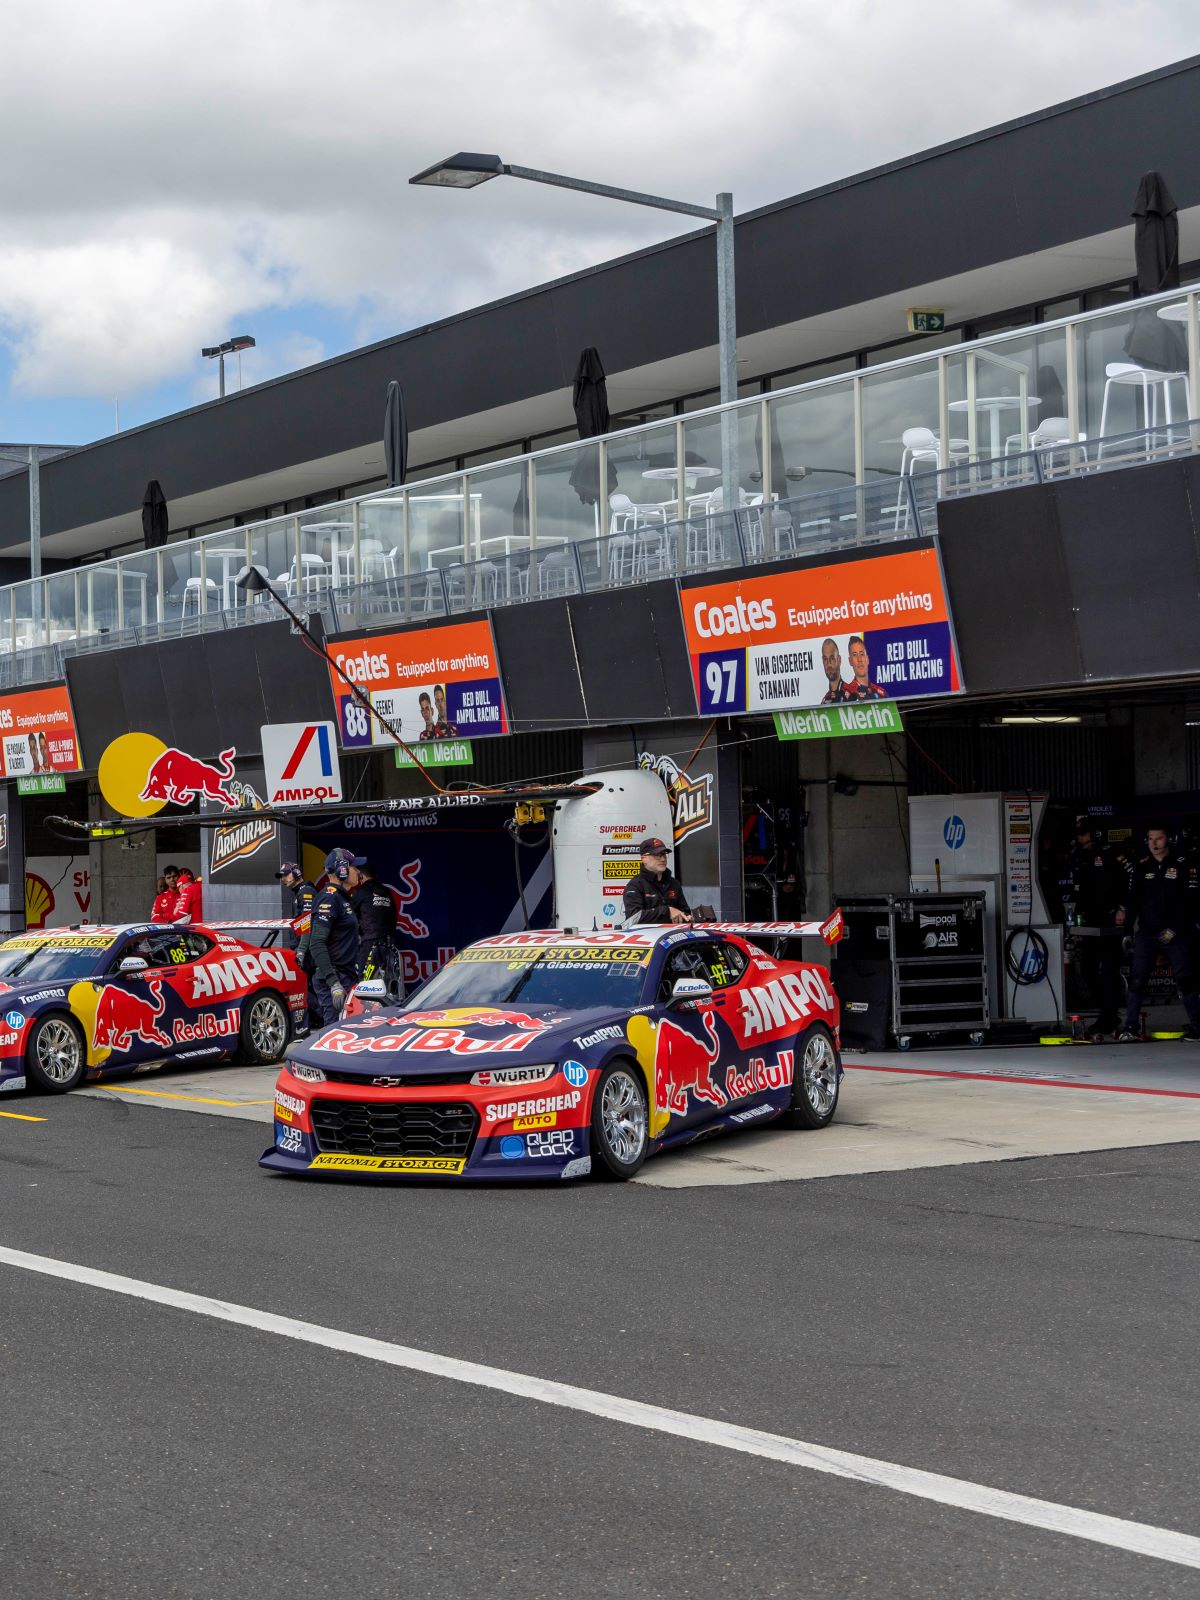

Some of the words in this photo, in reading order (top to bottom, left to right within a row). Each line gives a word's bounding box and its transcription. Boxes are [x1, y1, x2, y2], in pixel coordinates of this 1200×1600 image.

[693, 596, 777, 638] Coates
[787, 601, 849, 628] Equipped
[850, 599, 870, 618] for
[872, 590, 933, 615] anything
[886, 642, 906, 661] RED
[907, 639, 931, 658] BULL
[336, 651, 390, 684] Coates
[396, 658, 436, 678] Equipped
[436, 657, 449, 673] for
[450, 653, 489, 672] anything
[755, 655, 770, 677] VAN
[771, 651, 813, 674] GISBERGEN
[876, 662, 909, 685] AMPOL
[909, 658, 943, 682] RACING
[705, 659, 738, 705] 97
[758, 677, 801, 701] STANAWAY
[462, 691, 474, 706] RED
[475, 689, 491, 705] BULL
[376, 698, 394, 715] FEENEY
[456, 708, 477, 725] AMPOL
[477, 705, 499, 723] RACING
[344, 700, 368, 738] 88
[779, 710, 832, 736] Merlin
[838, 704, 895, 731] Merlin
[399, 746, 428, 764] Merlin
[433, 742, 469, 763] Merlin
[41, 775, 63, 790] Merlin
[272, 786, 339, 803] AMPOL
[388, 798, 424, 810] #AIR
[675, 791, 706, 826] ALL
[344, 814, 376, 829] GIVES
[377, 814, 400, 828] YOU
[402, 812, 438, 827] WINGS
[599, 824, 647, 834] SUPERCHEAP
[216, 821, 254, 861] ARMOR
[945, 818, 965, 848] hp
[605, 846, 641, 854] ToolPRO
[605, 887, 625, 895] Harvey
[604, 903, 615, 916] hp
[935, 913, 957, 925] paoli
[47, 937, 112, 947] STORAGE
[473, 932, 653, 948] AMPOL
[938, 931, 959, 943] AIR
[170, 948, 186, 963] 88
[455, 948, 540, 962] NATIONAL
[544, 948, 644, 961] STORAGE
[506, 961, 525, 970] 97
[547, 961, 609, 971] Gisbergen
[710, 963, 727, 985] 97
[192, 951, 297, 1000] AMPOL
[355, 985, 383, 993] ACDelco
[676, 983, 710, 992] ACDelco
[18, 988, 66, 1005] ToolPRO
[738, 967, 835, 1038] AMPOL
[8, 1012, 22, 1029] hp
[173, 1014, 205, 1044] Red
[204, 1007, 241, 1038] Bull
[309, 1028, 414, 1054] Red
[404, 1027, 542, 1054] Bull
[573, 1024, 625, 1051] ToolPRO
[295, 1062, 321, 1081] WÜRTH
[493, 1067, 546, 1083] WÜRTH
[567, 1060, 585, 1087] hp
[726, 1058, 755, 1101] Red
[753, 1049, 794, 1092] Bull
[275, 1089, 306, 1116] ERCHEAP
[485, 1090, 581, 1122] SUPERCHEAP
[517, 1115, 552, 1127] AUTO
[283, 1124, 302, 1141] QUAD
[526, 1129, 574, 1146] QUAD
[279, 1137, 302, 1153] LOCK
[527, 1141, 575, 1158] LOCK
[315, 1156, 378, 1167] NATIONAL
[383, 1159, 457, 1170] STORAGE
